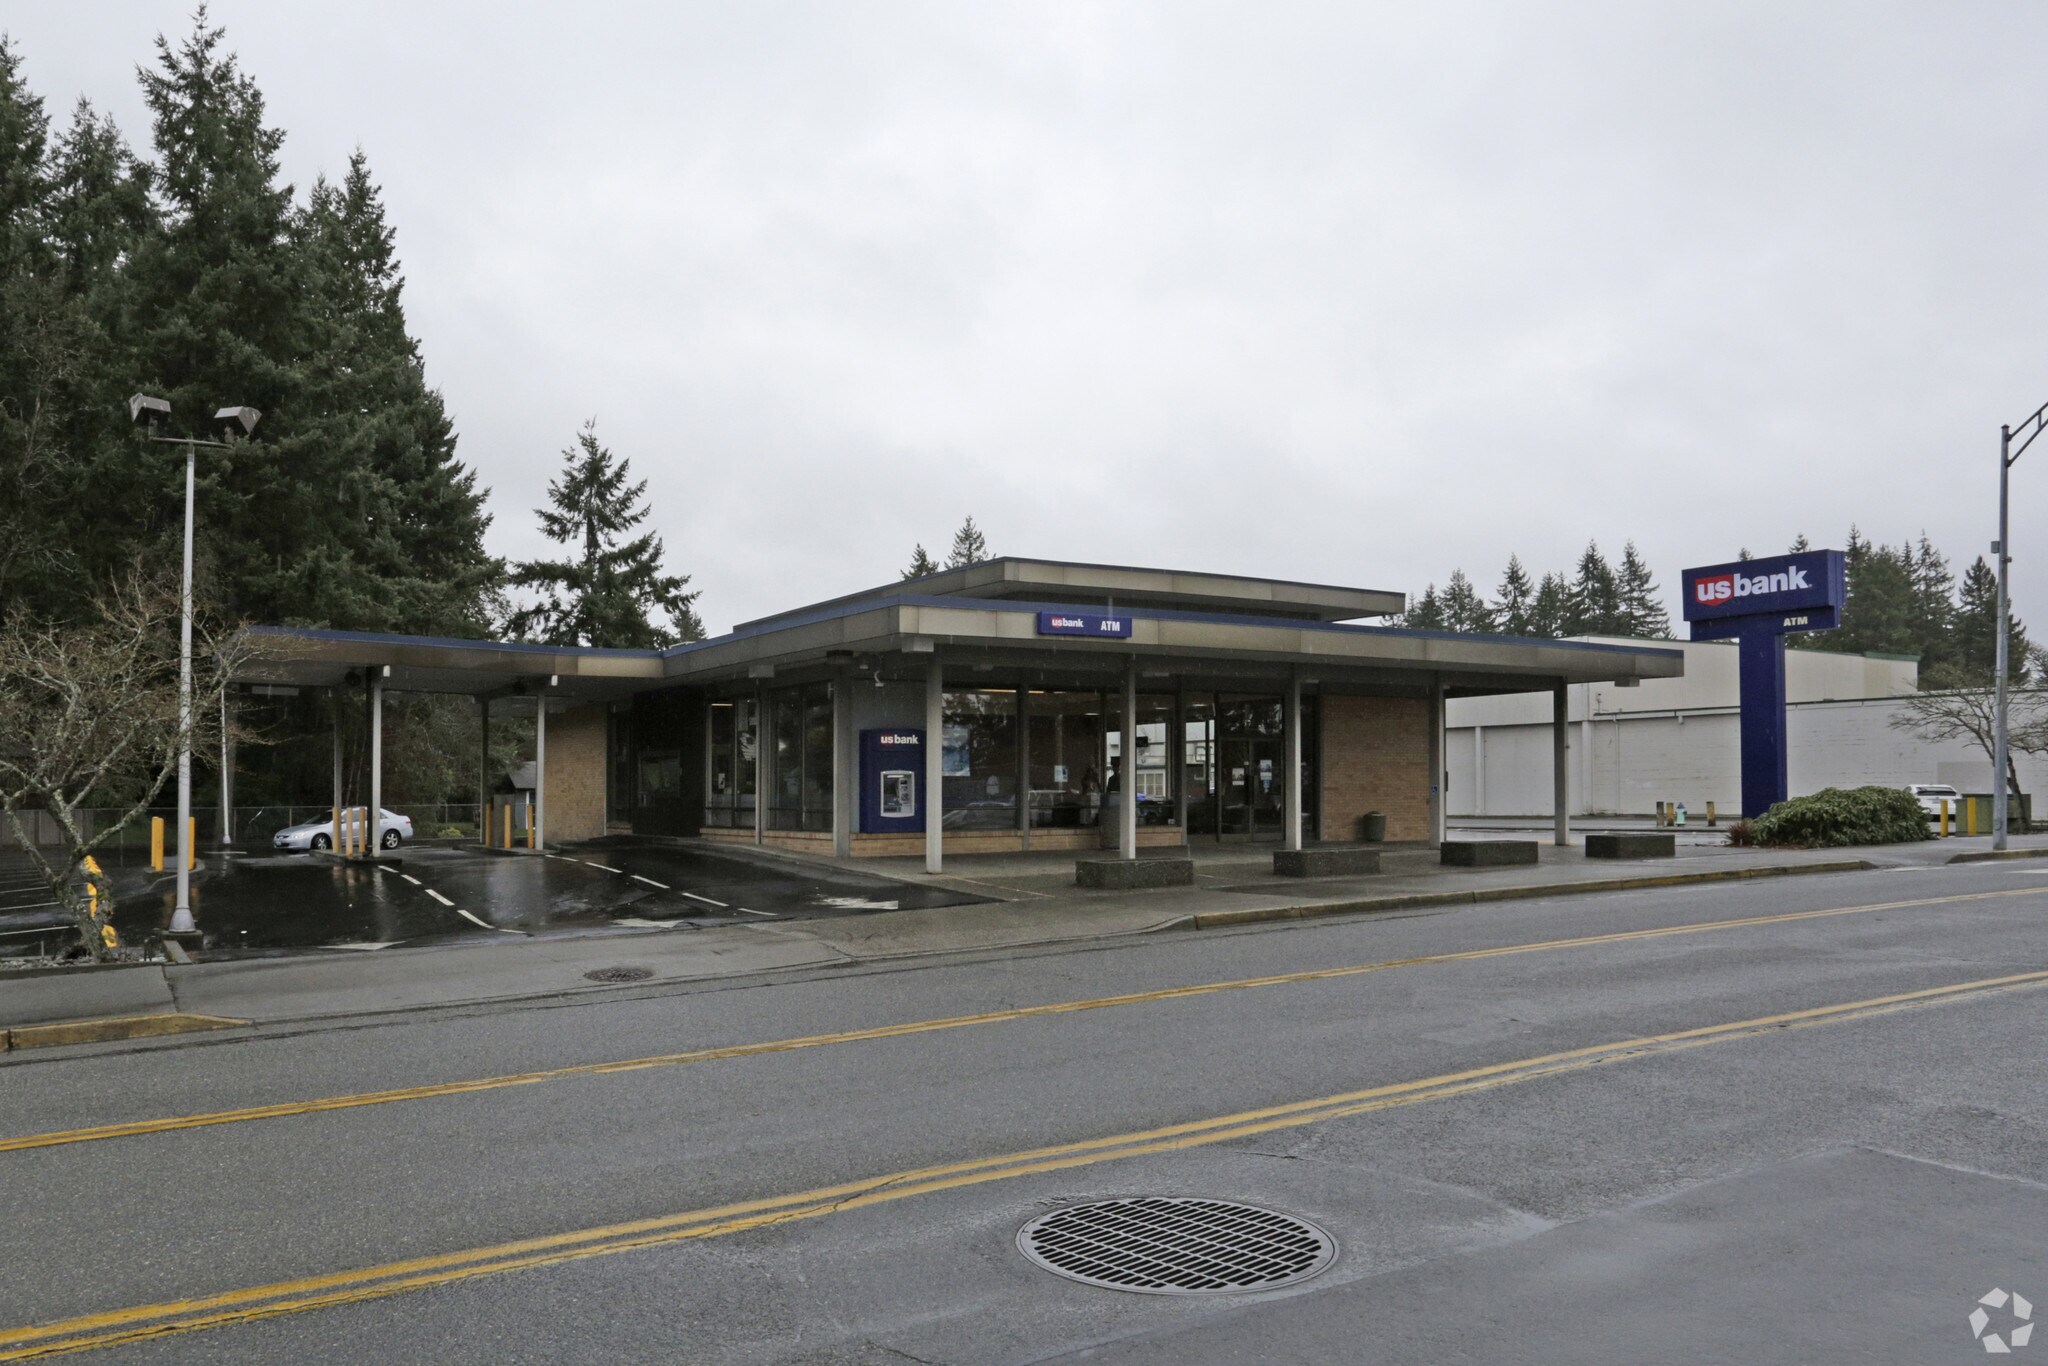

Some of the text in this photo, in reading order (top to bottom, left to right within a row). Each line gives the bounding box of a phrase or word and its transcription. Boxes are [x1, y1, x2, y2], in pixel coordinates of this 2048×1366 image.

[1696, 565, 1809, 602] usbank
[1051, 617, 1120, 631] usbank ATM
[1783, 616, 1808, 627] ATM
